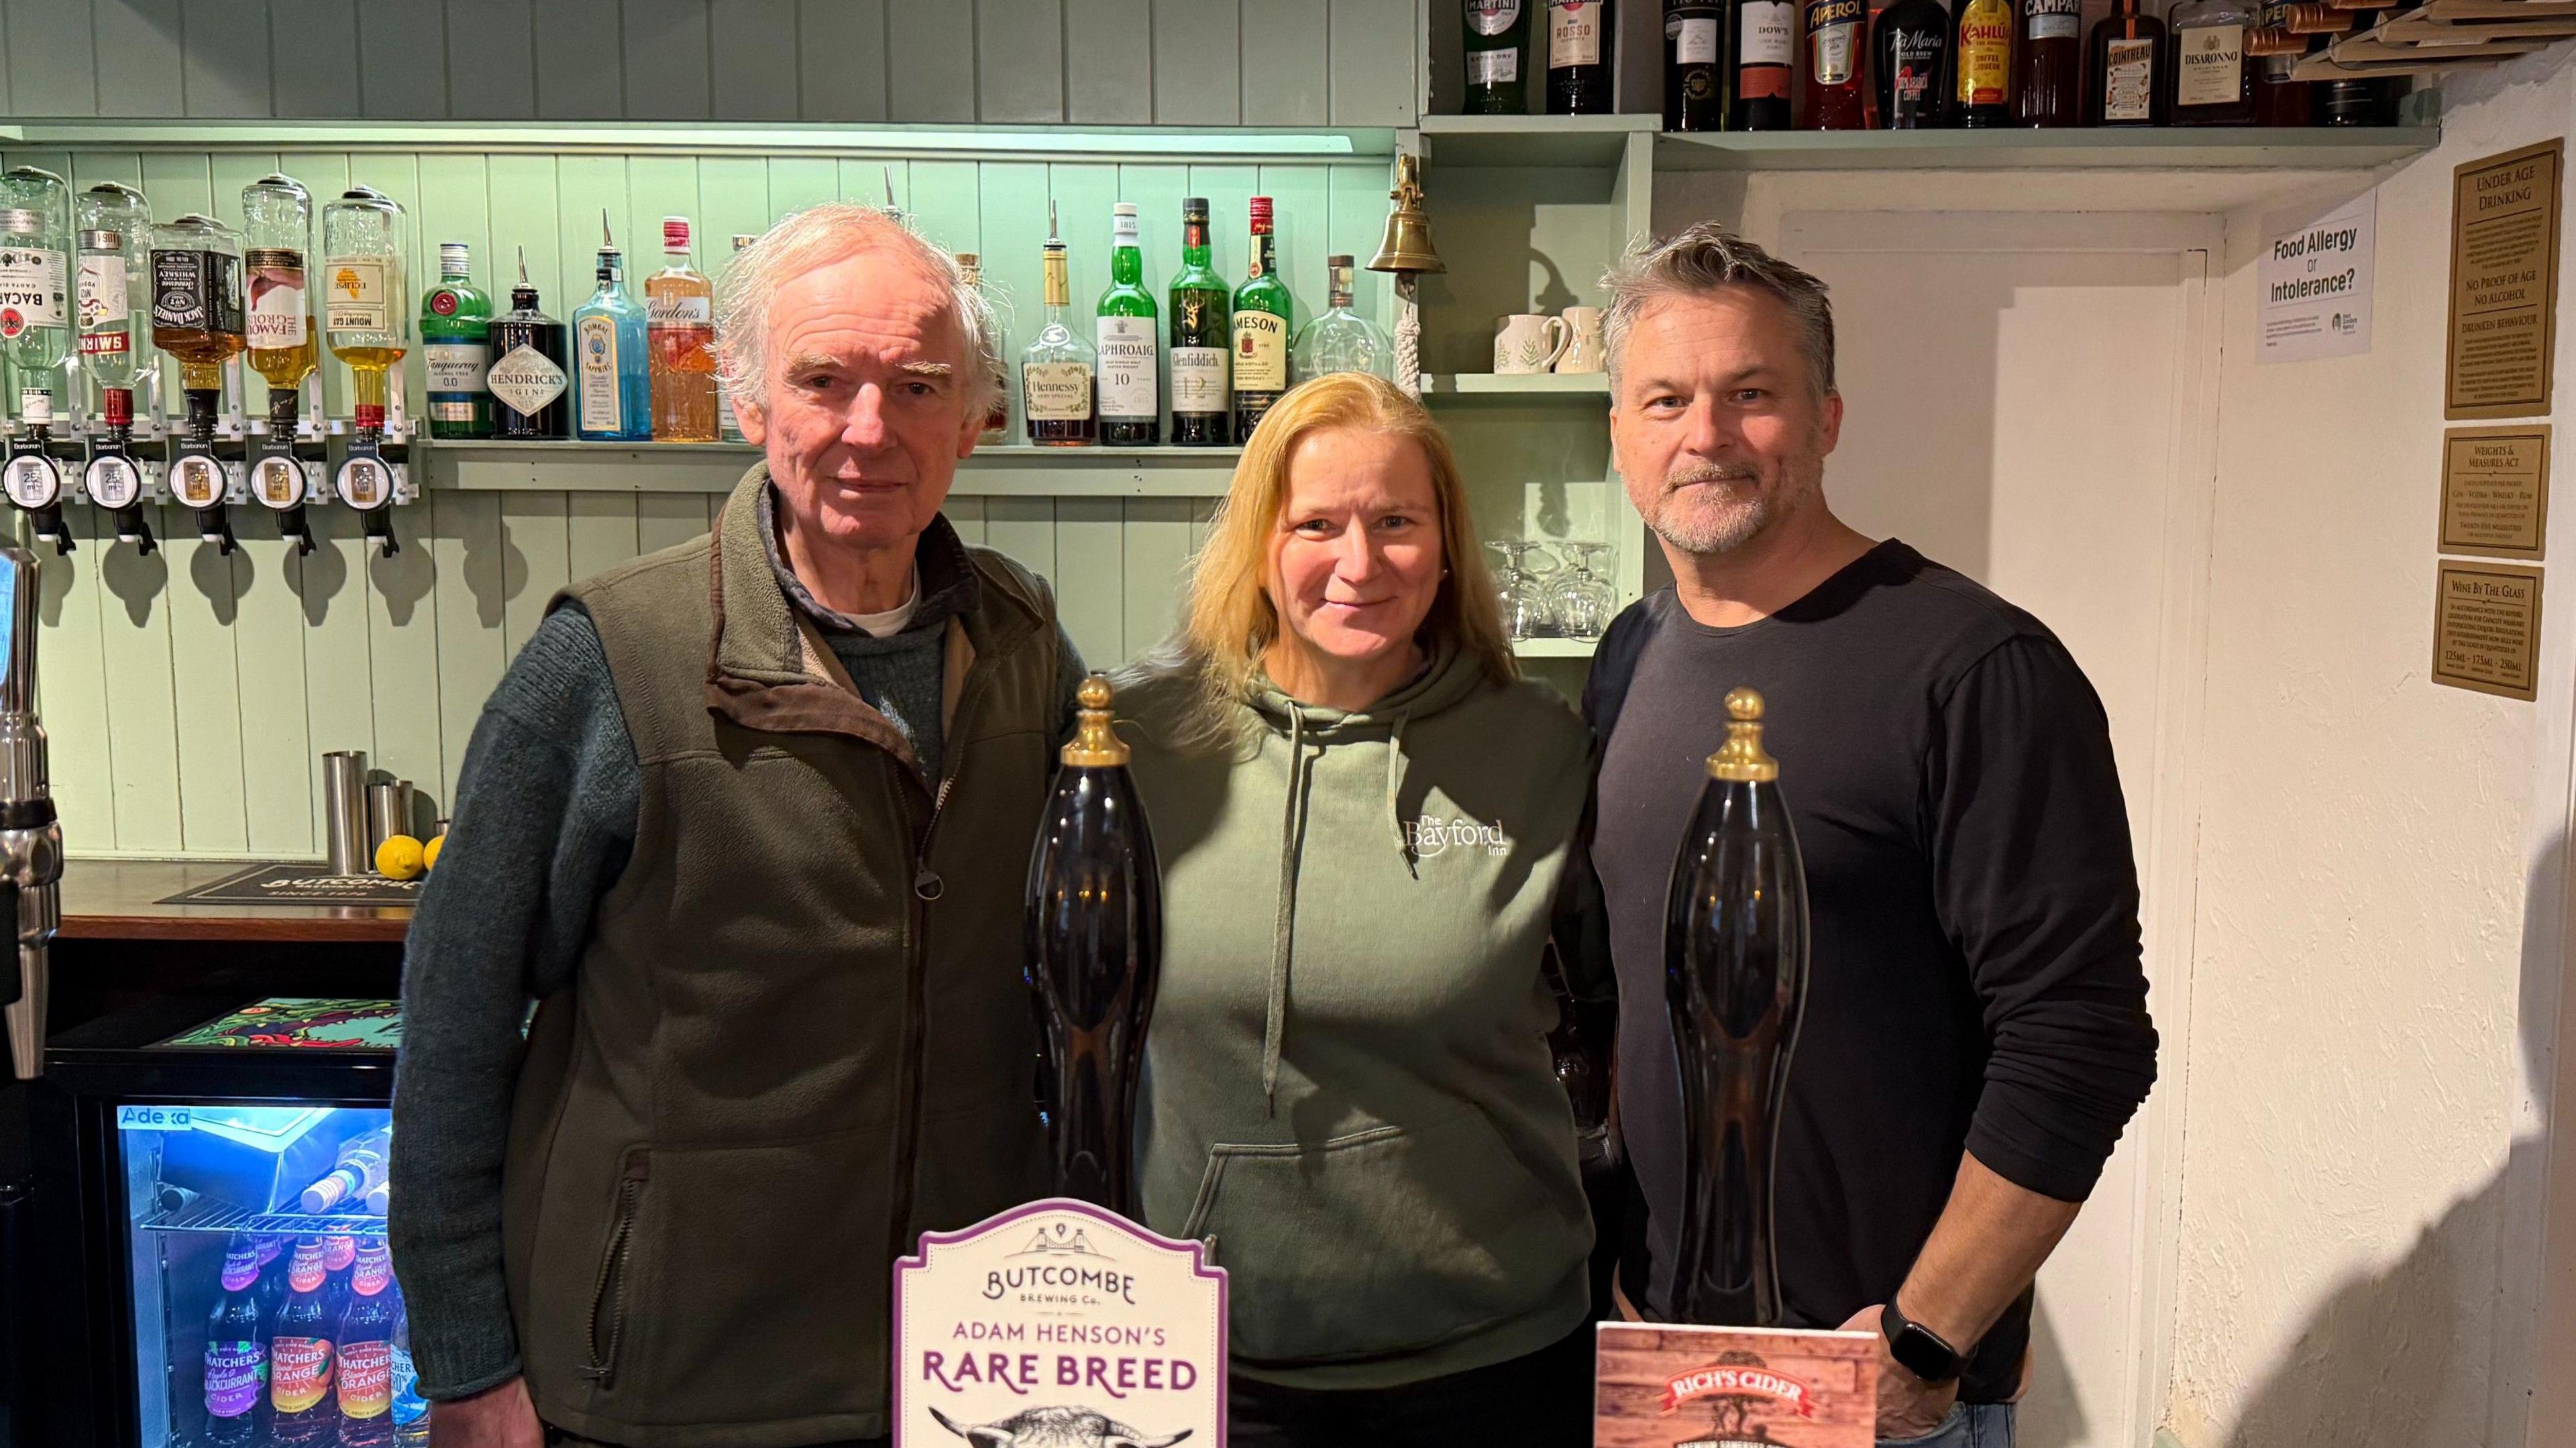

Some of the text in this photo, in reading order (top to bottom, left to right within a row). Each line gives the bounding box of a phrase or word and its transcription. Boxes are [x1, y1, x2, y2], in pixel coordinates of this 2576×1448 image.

[1811, 1, 1862, 28] APEROL
[1556, 24, 1590, 38] ROSSO
[1758, 26, 1789, 35] DOW'S
[1905, 29, 1943, 51] Maria
[2108, 44, 2151, 66] COINTREAU
[2185, 51, 2238, 65] DISARONNO
[2477, 166, 2535, 192] UNDER AGE
[2479, 187, 2531, 211] DRINKING
[1120, 220, 1136, 229] 1815
[2274, 228, 2357, 261] Food Allergy
[2308, 259, 2317, 272] or
[158, 270, 196, 278] WHISKEY
[2466, 270, 2536, 291] NO PROOF OF AGE
[161, 281, 194, 290] Tennessee
[334, 282, 366, 290] ECLIPSE
[2271, 268, 2355, 302] Intolerance?
[2475, 288, 2525, 306] NO ALCOHOL
[153, 304, 204, 325] JACK DANIEL'S
[647, 301, 700, 320] Gordon's
[287, 316, 297, 335] THE
[333, 317, 372, 327] MOUNT GAY
[2462, 314, 2538, 333] DRUNKEN BEHAVIOUR
[78, 336, 122, 351] SMIRN
[427, 357, 478, 373] Tanqueray
[1173, 353, 1219, 367] Glenfiddich
[443, 377, 458, 387] 0.0
[490, 374, 564, 385] HENDRICK'S
[1116, 373, 1130, 386] 10
[1033, 381, 1079, 394] Hennessy
[2474, 445, 2514, 456] WEIGHTS &
[2469, 457, 2520, 467] MEASURES ACT
[1420, 815, 1442, 826] The
[1403, 819, 1507, 857] Bayford
[1488, 846, 1507, 856] Inn
[121, 1108, 190, 1125] Adexa
[982, 1266, 1136, 1304] BUTCOMBE
[1020, 1294, 1077, 1304] BREWING
[953, 1321, 1165, 1346] ADAM HENSON'S
[922, 1350, 1197, 1398] RARE BREED
[276, 1386, 307, 1396] CIDER
[1671, 1370, 1803, 1402] RICH'S CIDER
[211, 1392, 244, 1403] CIDER
[350, 1392, 383, 1402] CIDER
